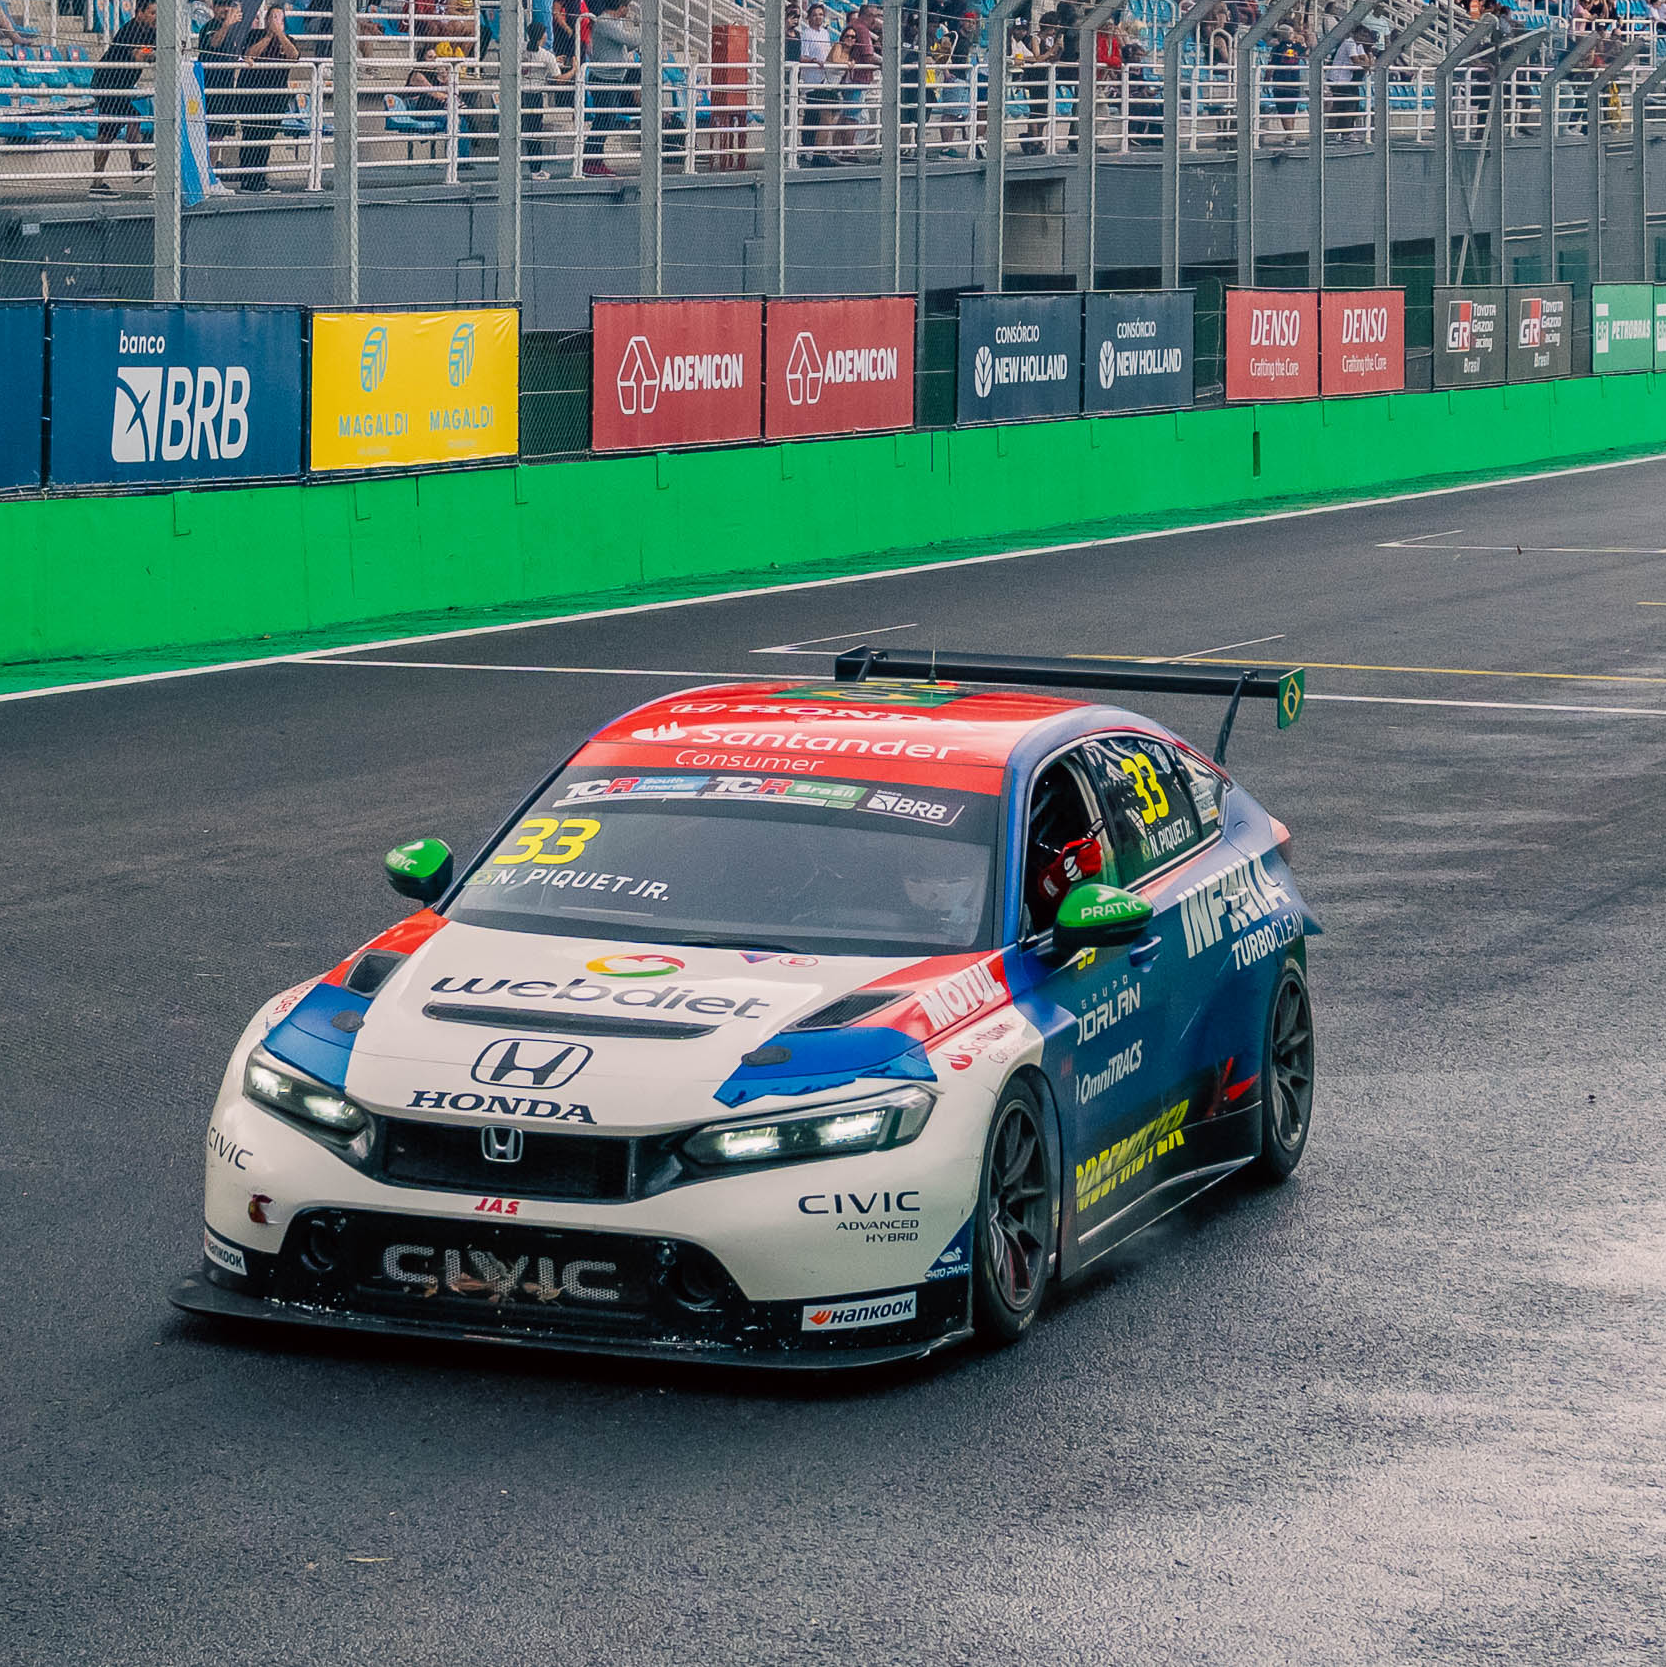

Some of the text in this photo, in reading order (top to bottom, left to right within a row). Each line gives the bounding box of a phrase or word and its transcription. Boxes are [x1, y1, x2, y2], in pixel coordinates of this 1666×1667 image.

[1473, 303, 1496, 316] TOYOTA
[1542, 300, 1563, 313] TOYOTA
[995, 321, 1040, 345] CONSÓRCIO
[1117, 317, 1156, 340] CONSÓRCIO
[1250, 309, 1300, 347] DENSO
[1342, 307, 1388, 344] DENSO
[1448, 322, 1470, 348] GR
[1520, 318, 1540, 344] GR
[1612, 319, 1650, 340] PETROBRAS
[119, 330, 166, 355] banco
[661, 354, 744, 393] ADEMICON
[824, 347, 898, 384] ADEMICON
[995, 353, 1067, 384] NEW HOLLAND
[1116, 347, 1182, 377] NEW HOLLAND
[1250, 358, 1299, 379] Crafting the Core
[1342, 355, 1387, 376] Crafting the Core
[160, 366, 251, 461] BRB
[338, 413, 409, 438] MAGALDI
[429, 405, 494, 432] MAGALDI
[692, 728, 961, 760] Santander
[675, 749, 824, 772] Consumer
[564, 777, 639, 799] TCR
[714, 776, 857, 798] TCR Brasil
[1120, 753, 1169, 825] 33
[893, 797, 949, 820] BRB
[493, 818, 601, 865] 33
[1158, 816, 1187, 854] PIQUET
[491, 869, 670, 901] N. PIQUET JR.
[1081, 899, 1142, 920] PRATYC
[431, 977, 770, 1019] webdiet
[916, 961, 1007, 1030] MOTUL
[1081, 974, 1128, 1010] GRUPO
[406, 1090, 598, 1125] HONDA
[207, 1125, 253, 1171] CIVIC
[474, 1197, 521, 1215] JAS
[798, 1191, 920, 1214] CIVIC
[836, 1219, 919, 1231] ADVANCED
[866, 1232, 919, 1243] HYBRID
[383, 1244, 619, 1302] CIVIC
